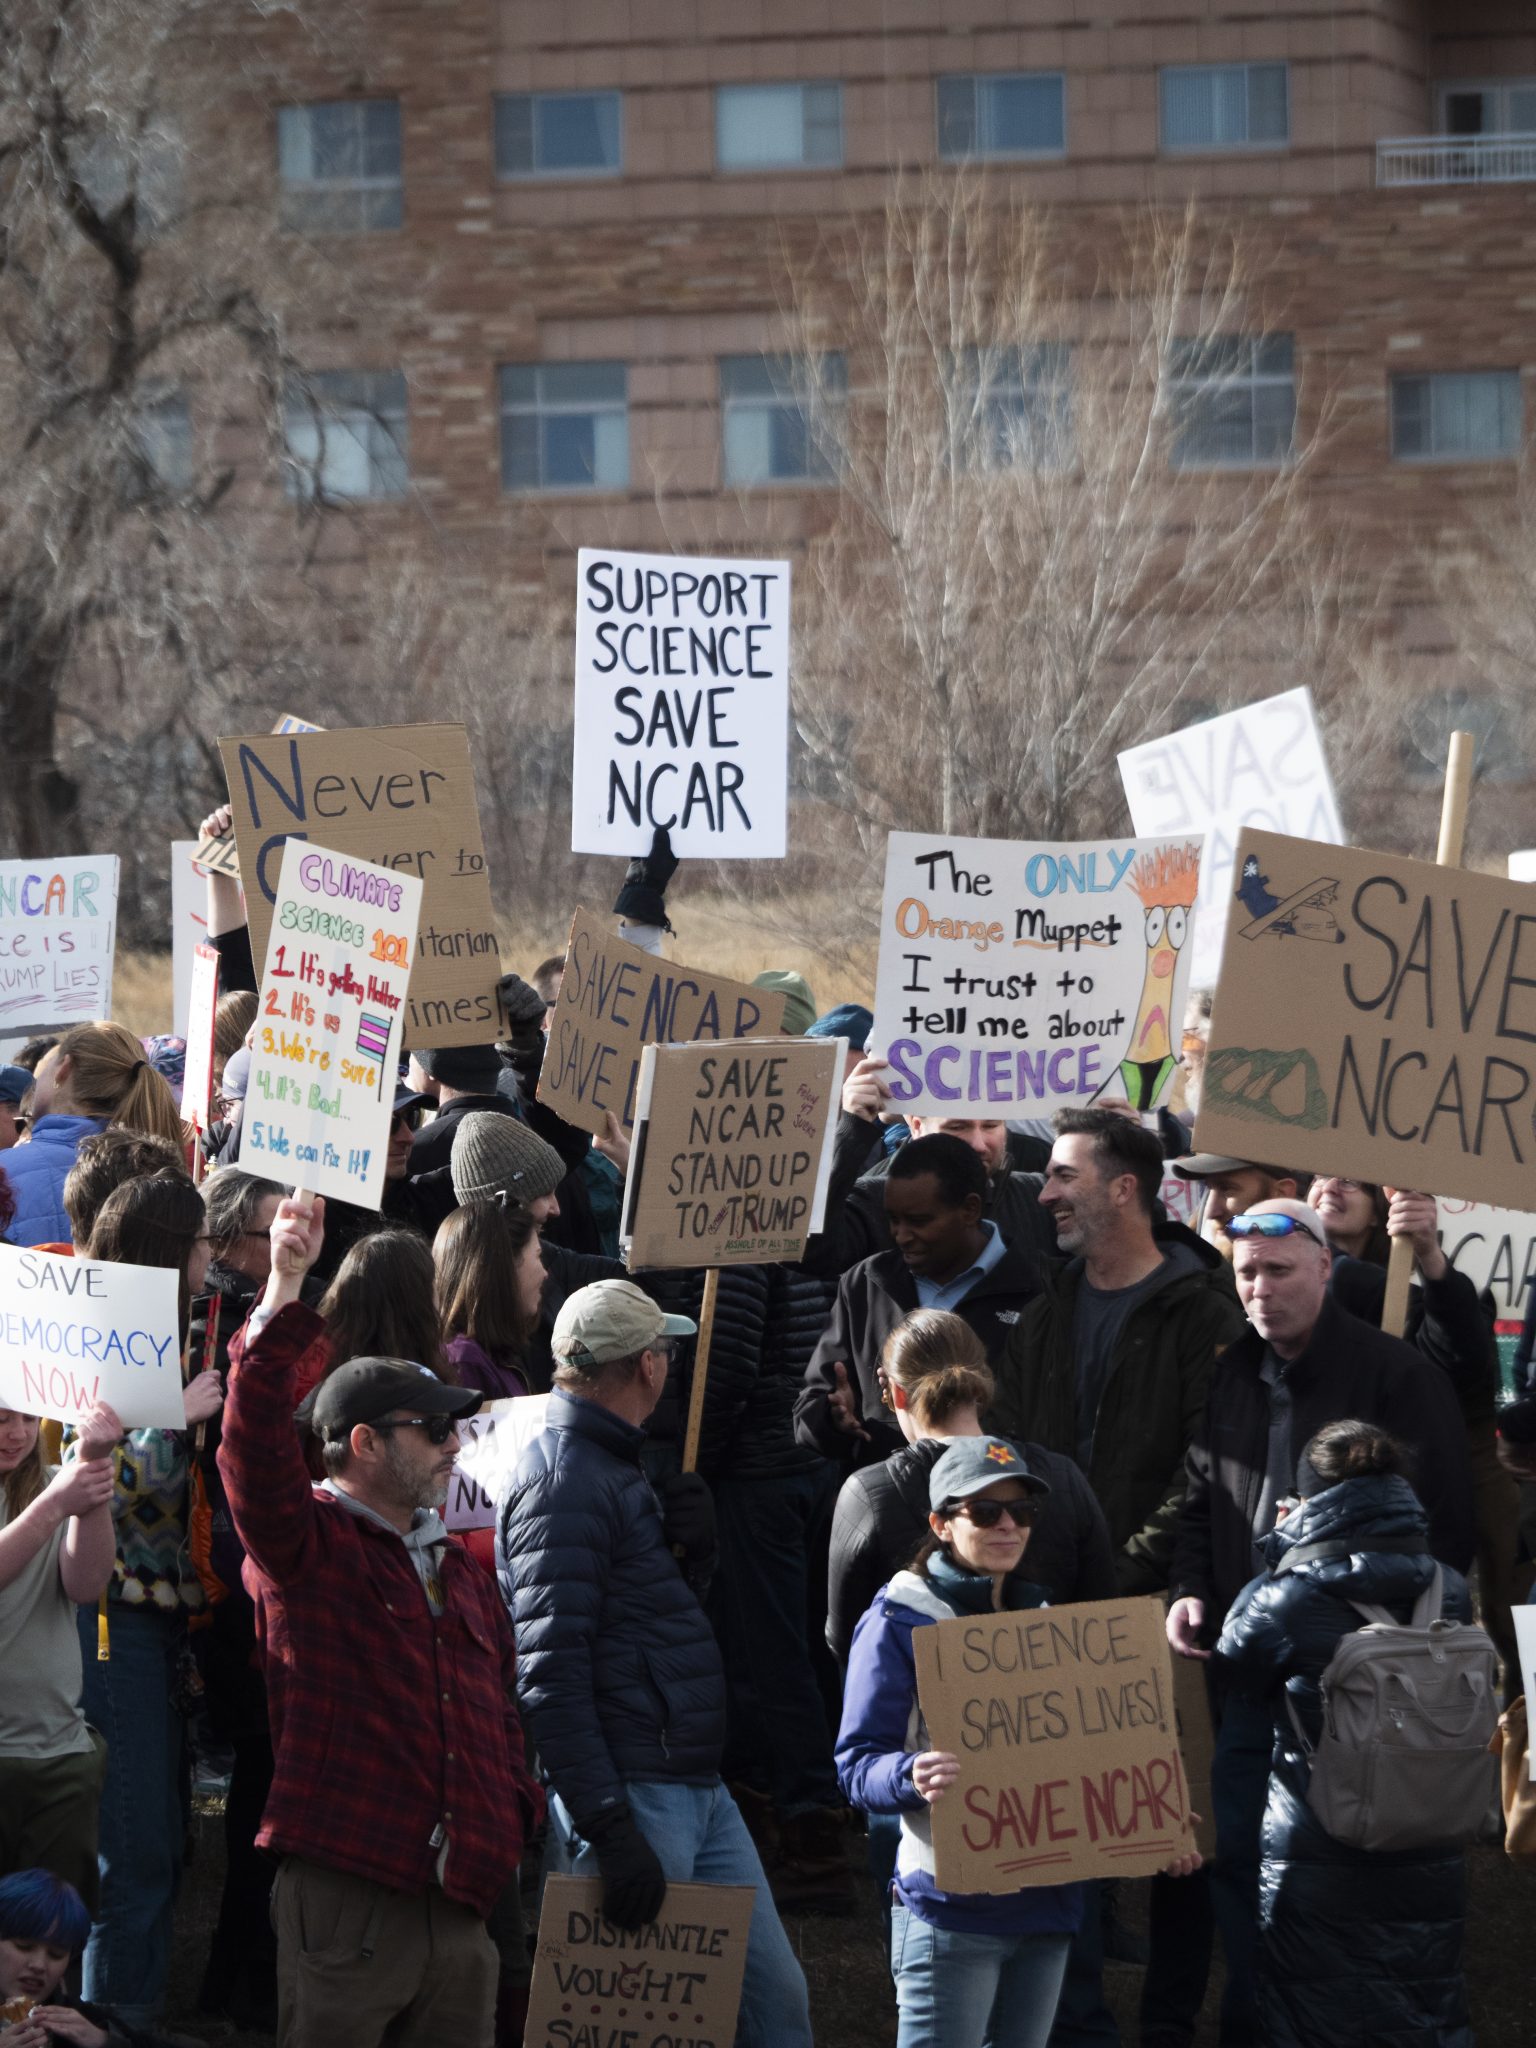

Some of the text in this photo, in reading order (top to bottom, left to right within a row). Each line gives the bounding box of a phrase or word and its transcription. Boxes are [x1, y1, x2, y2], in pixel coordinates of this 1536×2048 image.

[586, 561, 779, 620] SUPPORT
[592, 621, 773, 679] SCIENCE
[614, 686, 740, 749] SAVE
[238, 739, 446, 829] Never
[606, 759, 751, 832] NCAR
[300, 854, 403, 912] CLIMATE
[455, 848, 485, 873] to
[915, 848, 1136, 898] The ONLY
[0, 871, 100, 918] NCAR
[43, 931, 76, 954] is
[280, 901, 409, 969] SCIENCE 101
[419, 926, 498, 958] itarian
[895, 898, 1122, 952] Orange Muppet
[53, 960, 100, 992] LIES
[270, 945, 295, 977] 1.
[300, 951, 325, 986] It's
[902, 954, 1095, 1000] I trust to
[1343, 876, 1536, 1043] SAVE
[265, 988, 340, 1034] 2. It's us
[567, 931, 761, 1043] SAVE NCAR
[902, 1006, 1125, 1039] tell me about
[256, 1070, 274, 1100] 4.
[340, 1058, 375, 1087] sure
[550, 1019, 618, 1110] SAVE
[696, 1057, 788, 1100] SAVE
[887, 1038, 1101, 1102] SCIENCE
[1332, 1034, 1524, 1164] NCAR
[250, 1121, 265, 1149] 5.
[268, 1125, 289, 1157] We
[295, 1143, 318, 1162] can
[689, 1103, 785, 1145] NCAR
[667, 1151, 811, 1196] STAND UP
[674, 1201, 709, 1239] TO
[726, 1195, 807, 1238] TRUMP
[17, 1253, 108, 1298] SAVE
[21, 1360, 99, 1410] NOW
[962, 1615, 1141, 1674] SCIENCE
[960, 1667, 1168, 1751] SAVES LIVES!
[961, 1748, 1187, 1852] SAVE NCAR!
[552, 1960, 707, 2005] VOUGHT
